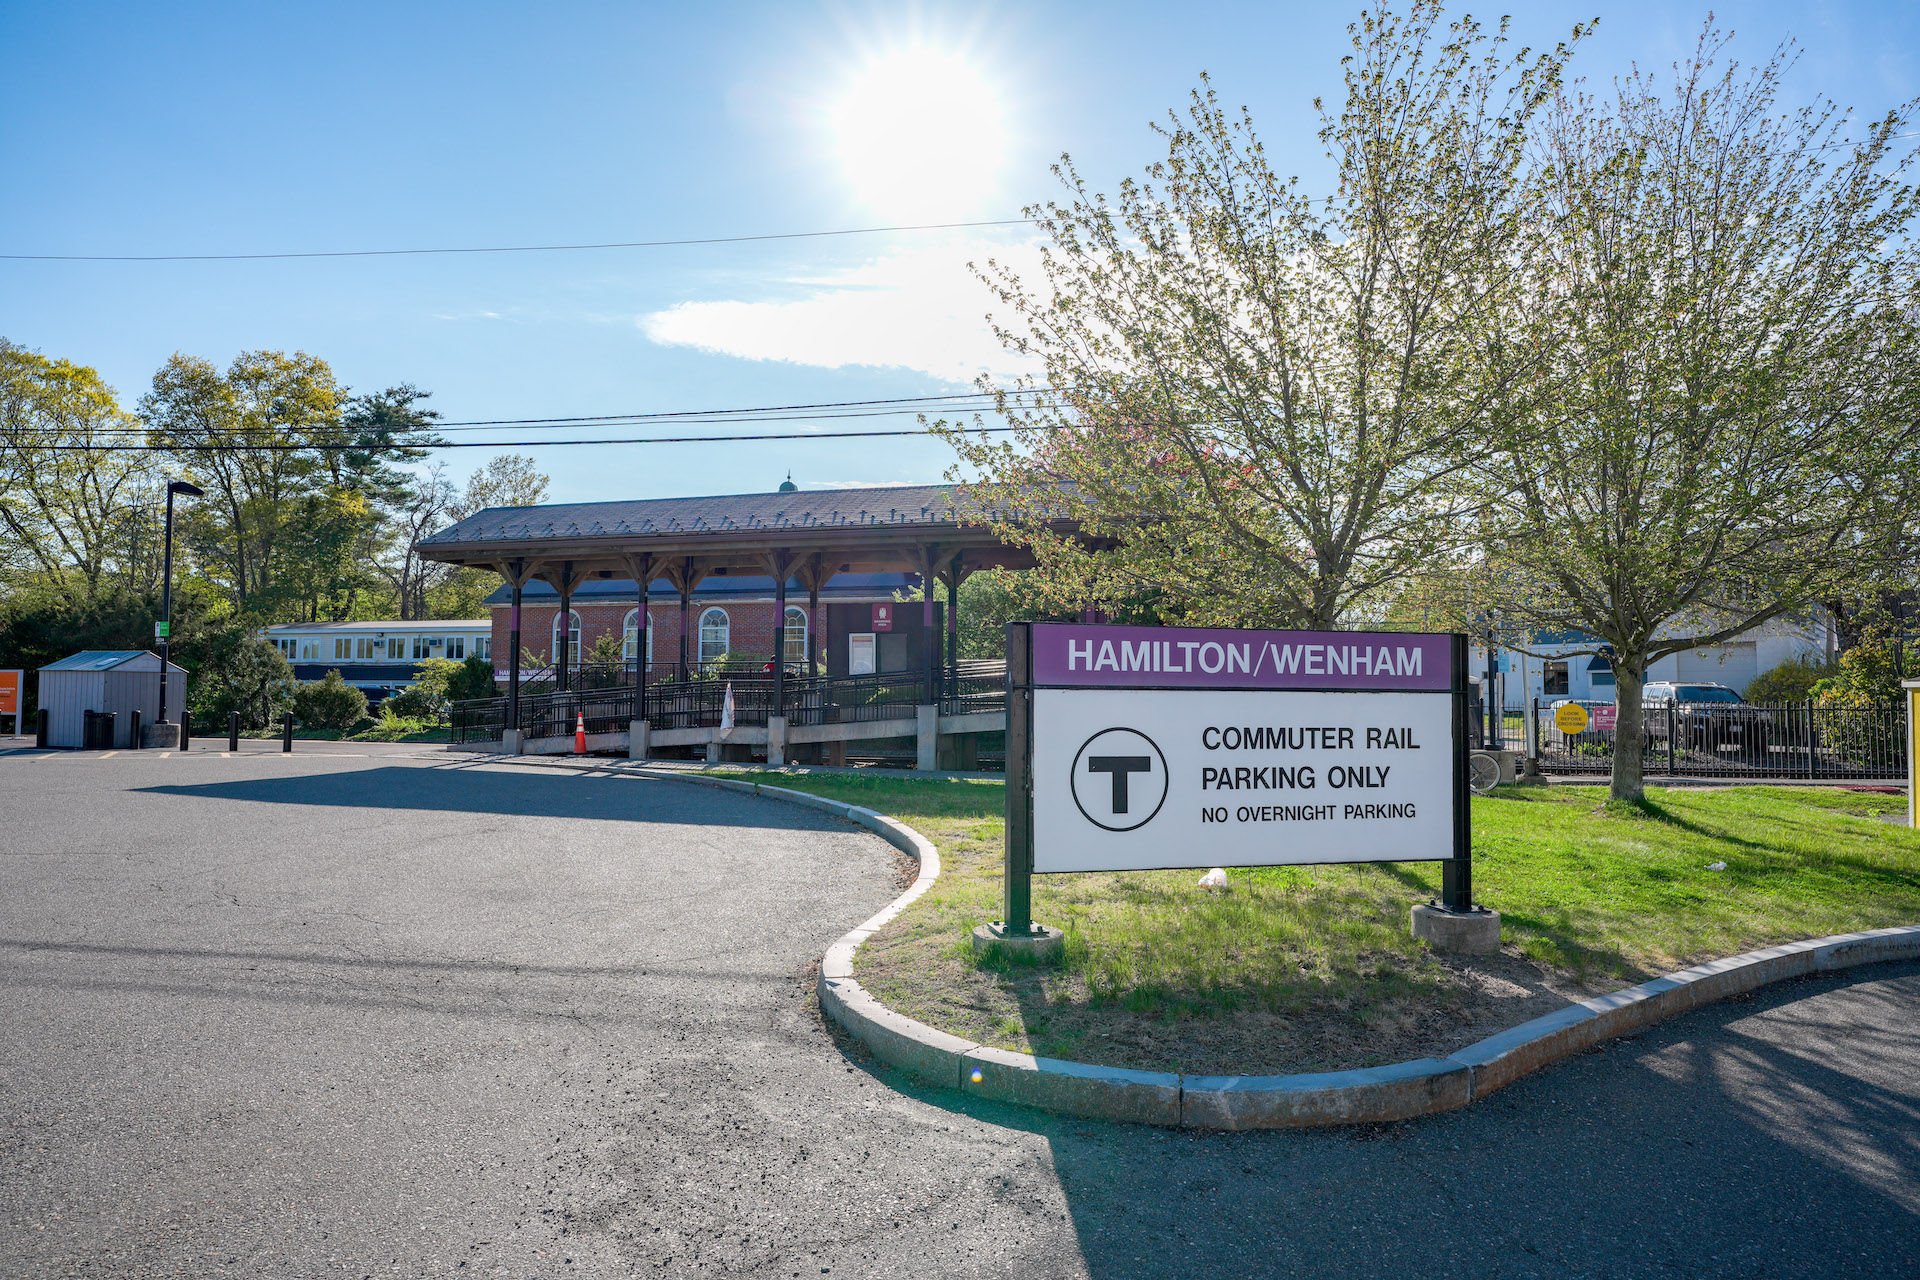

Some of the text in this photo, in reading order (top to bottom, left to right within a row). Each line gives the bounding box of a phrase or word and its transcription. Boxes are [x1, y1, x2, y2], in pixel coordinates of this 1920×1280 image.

[1068, 639, 1422, 677] HAMILTON/WENHAM
[1202, 726, 1421, 750] COMMUTER RAIL
[1088, 756, 1151, 814] T
[1202, 765, 1391, 790] PARKING ONLY
[1202, 803, 1416, 823] NO OVERNIGHT PARKING
